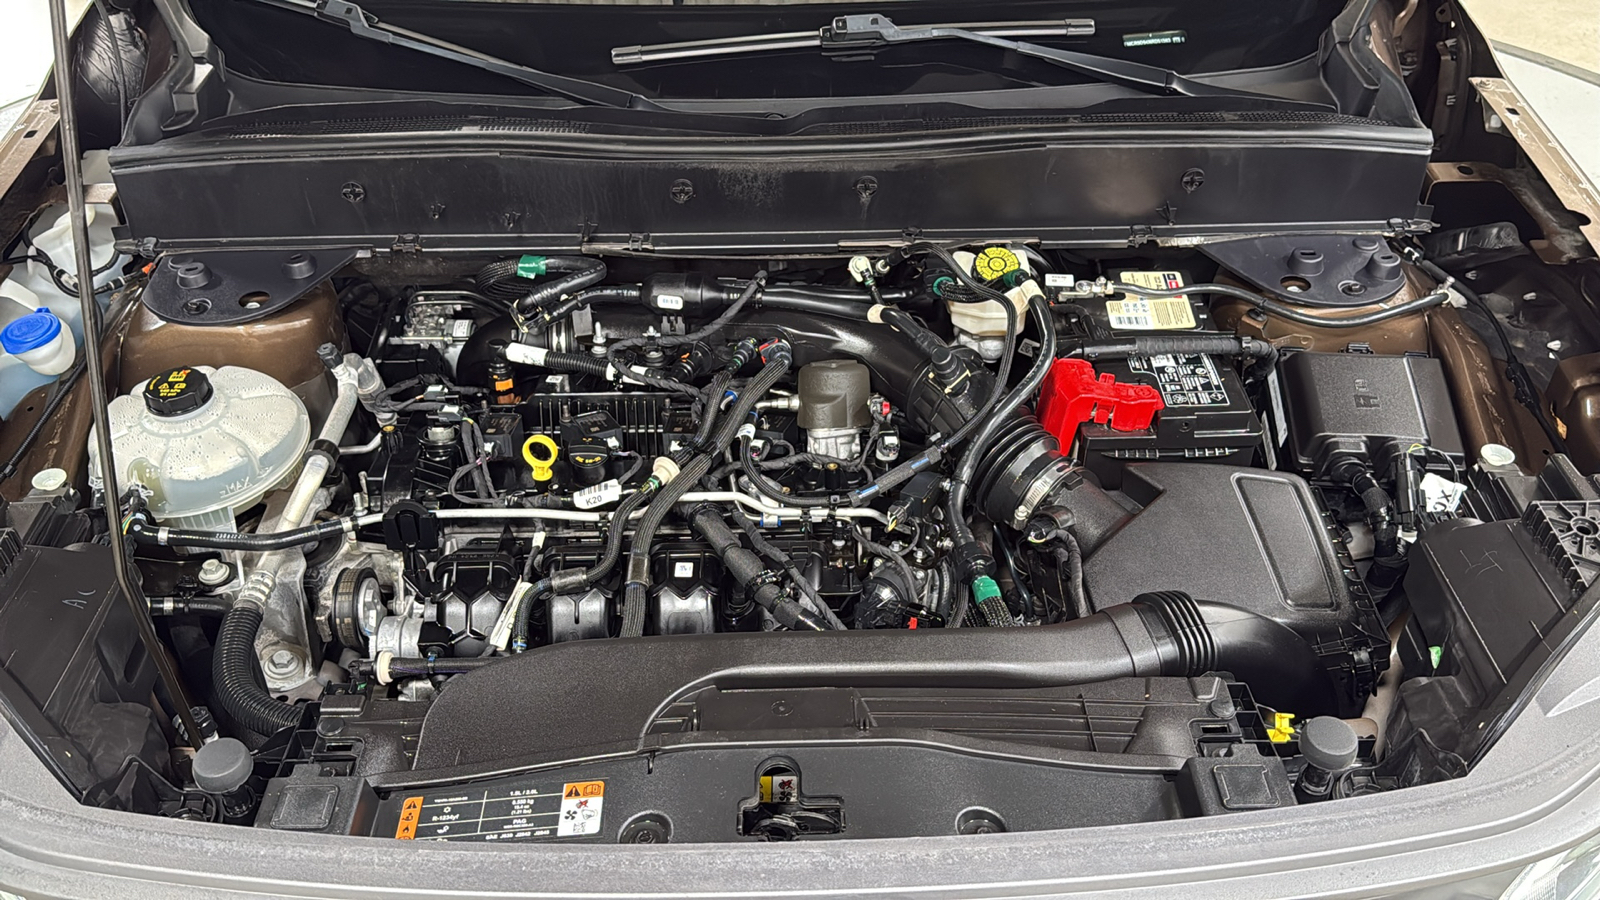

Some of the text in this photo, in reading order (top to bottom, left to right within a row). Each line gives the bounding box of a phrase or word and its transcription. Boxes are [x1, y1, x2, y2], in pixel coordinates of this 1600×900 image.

[225, 476, 253, 494] MAX
[585, 495, 602, 506] K20
[432, 813, 460, 822] R-1234yf
